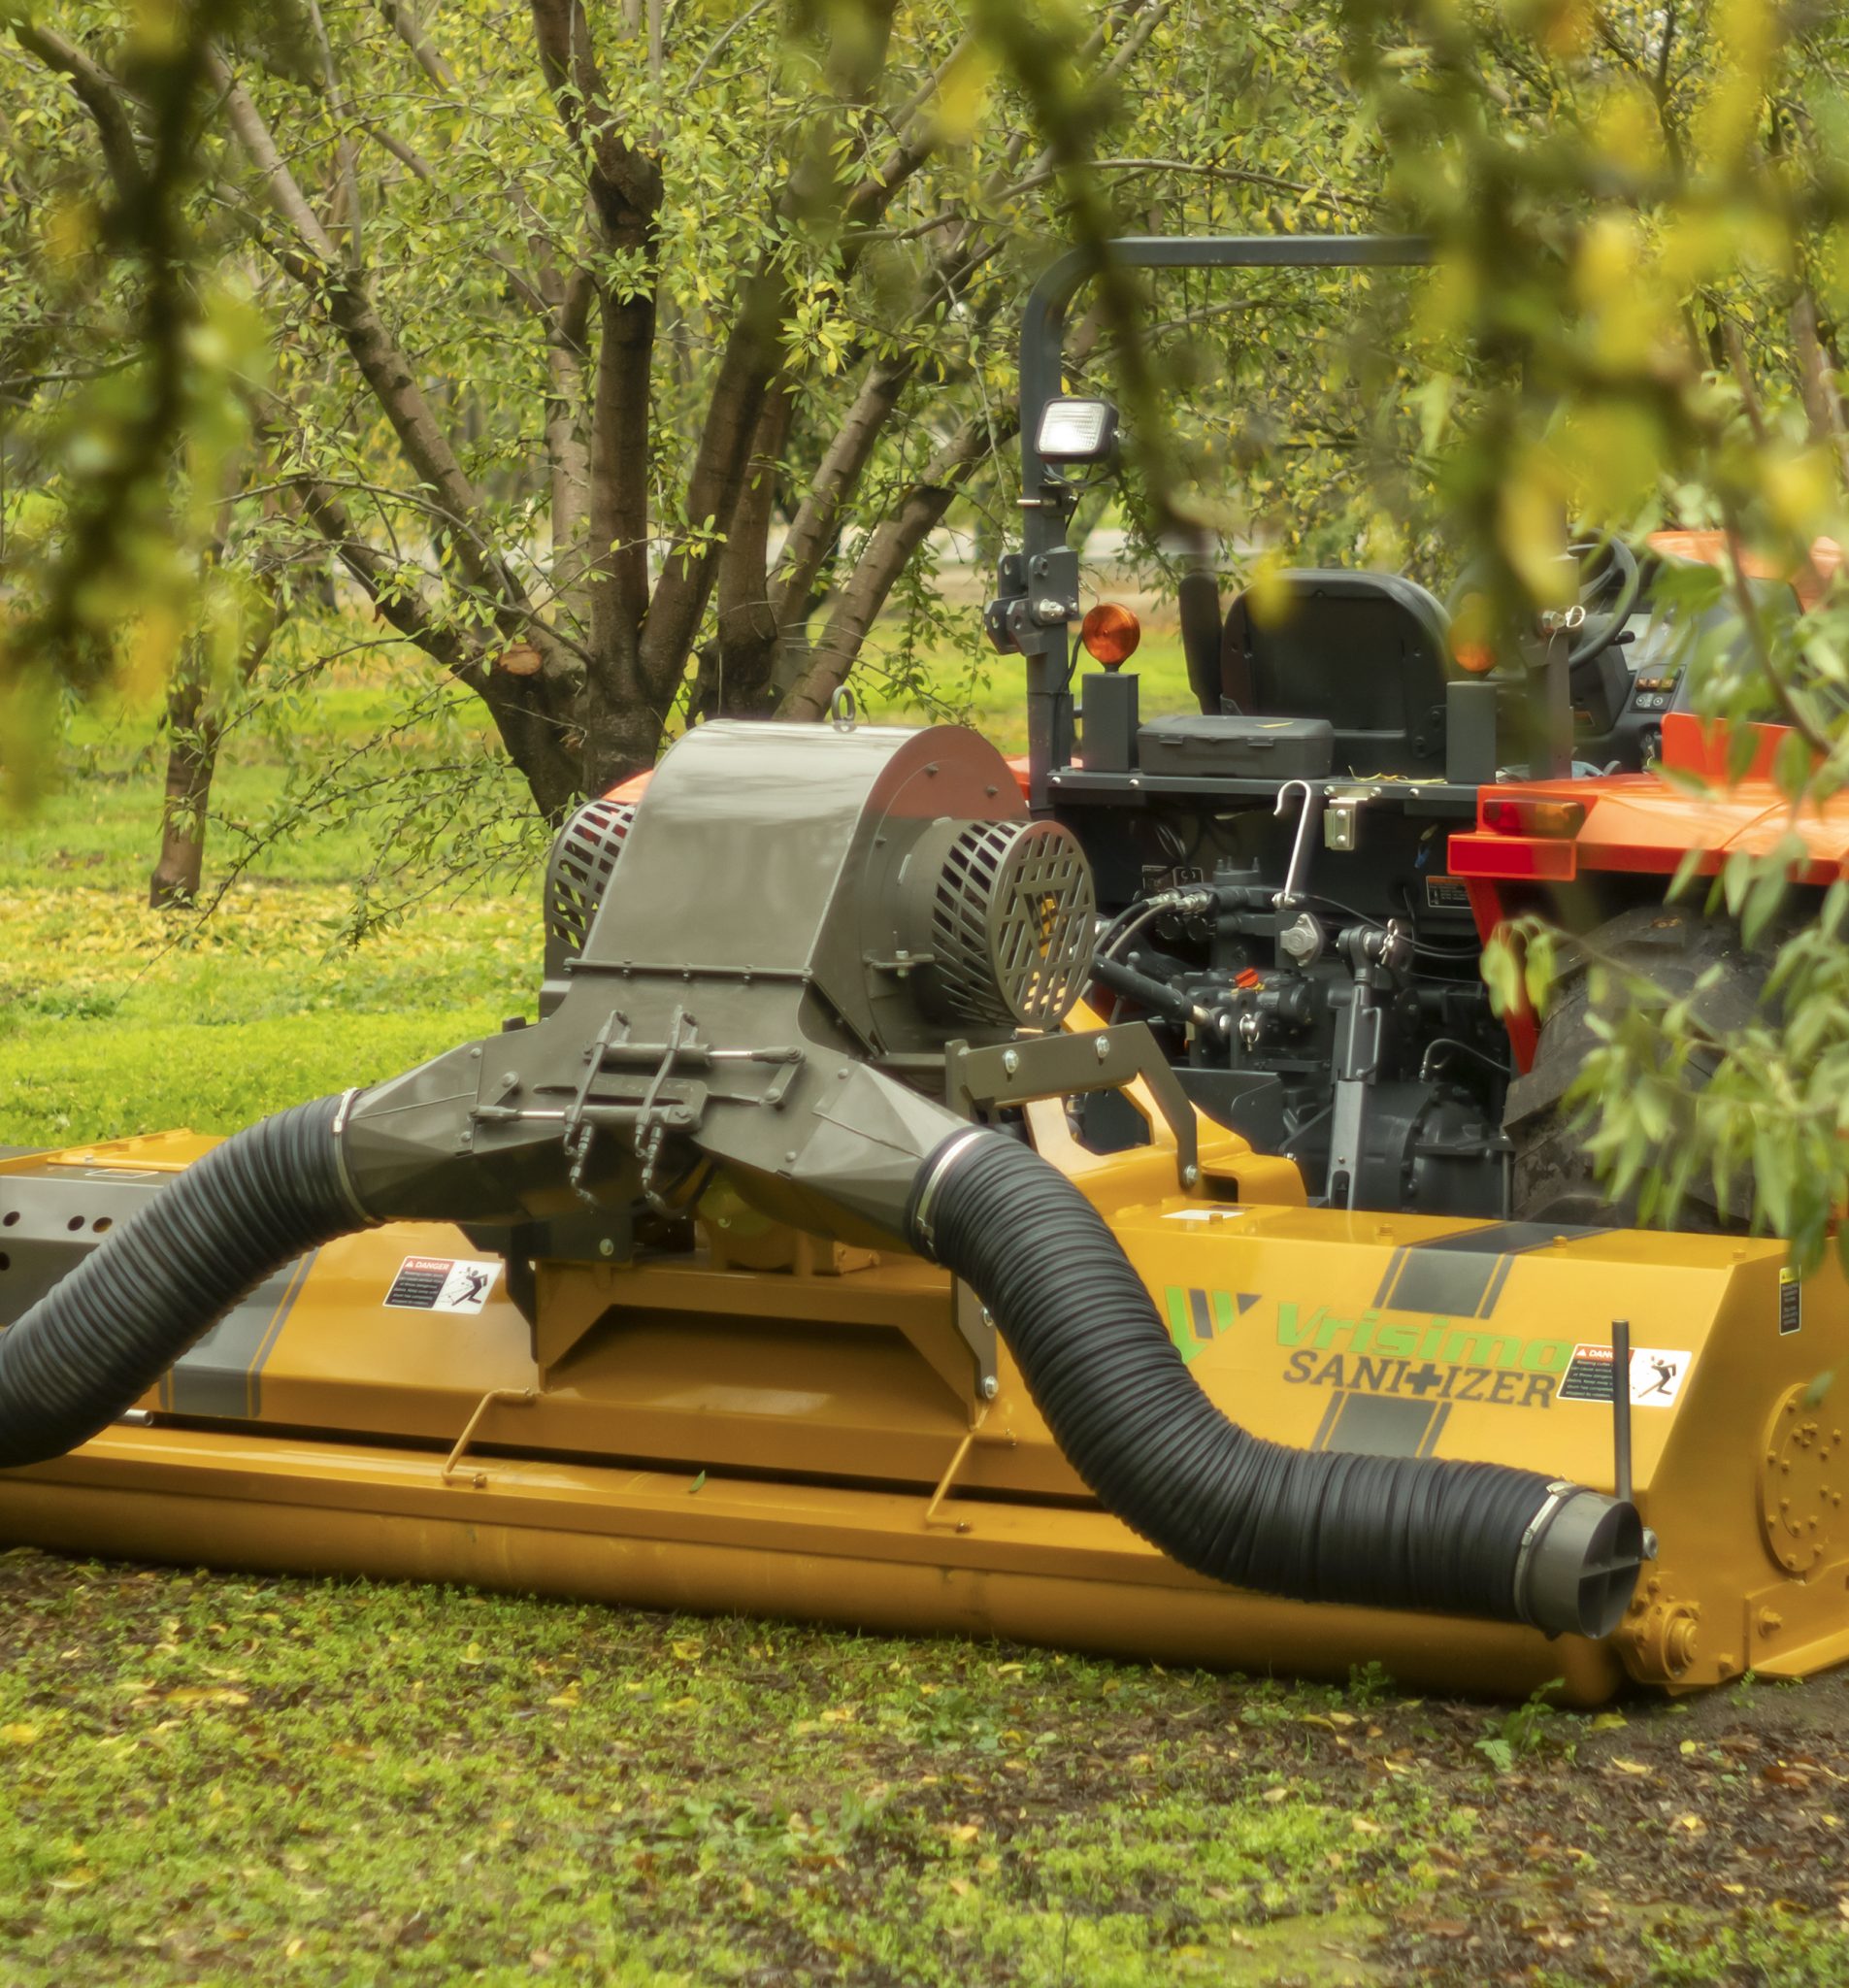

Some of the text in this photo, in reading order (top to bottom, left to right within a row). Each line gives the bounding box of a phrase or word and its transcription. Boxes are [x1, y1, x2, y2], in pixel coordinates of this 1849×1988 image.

[414, 1261, 450, 1271] DANGER
[1277, 1303, 1573, 1374] Vrisimo
[1588, 1349, 1614, 1358] DAN
